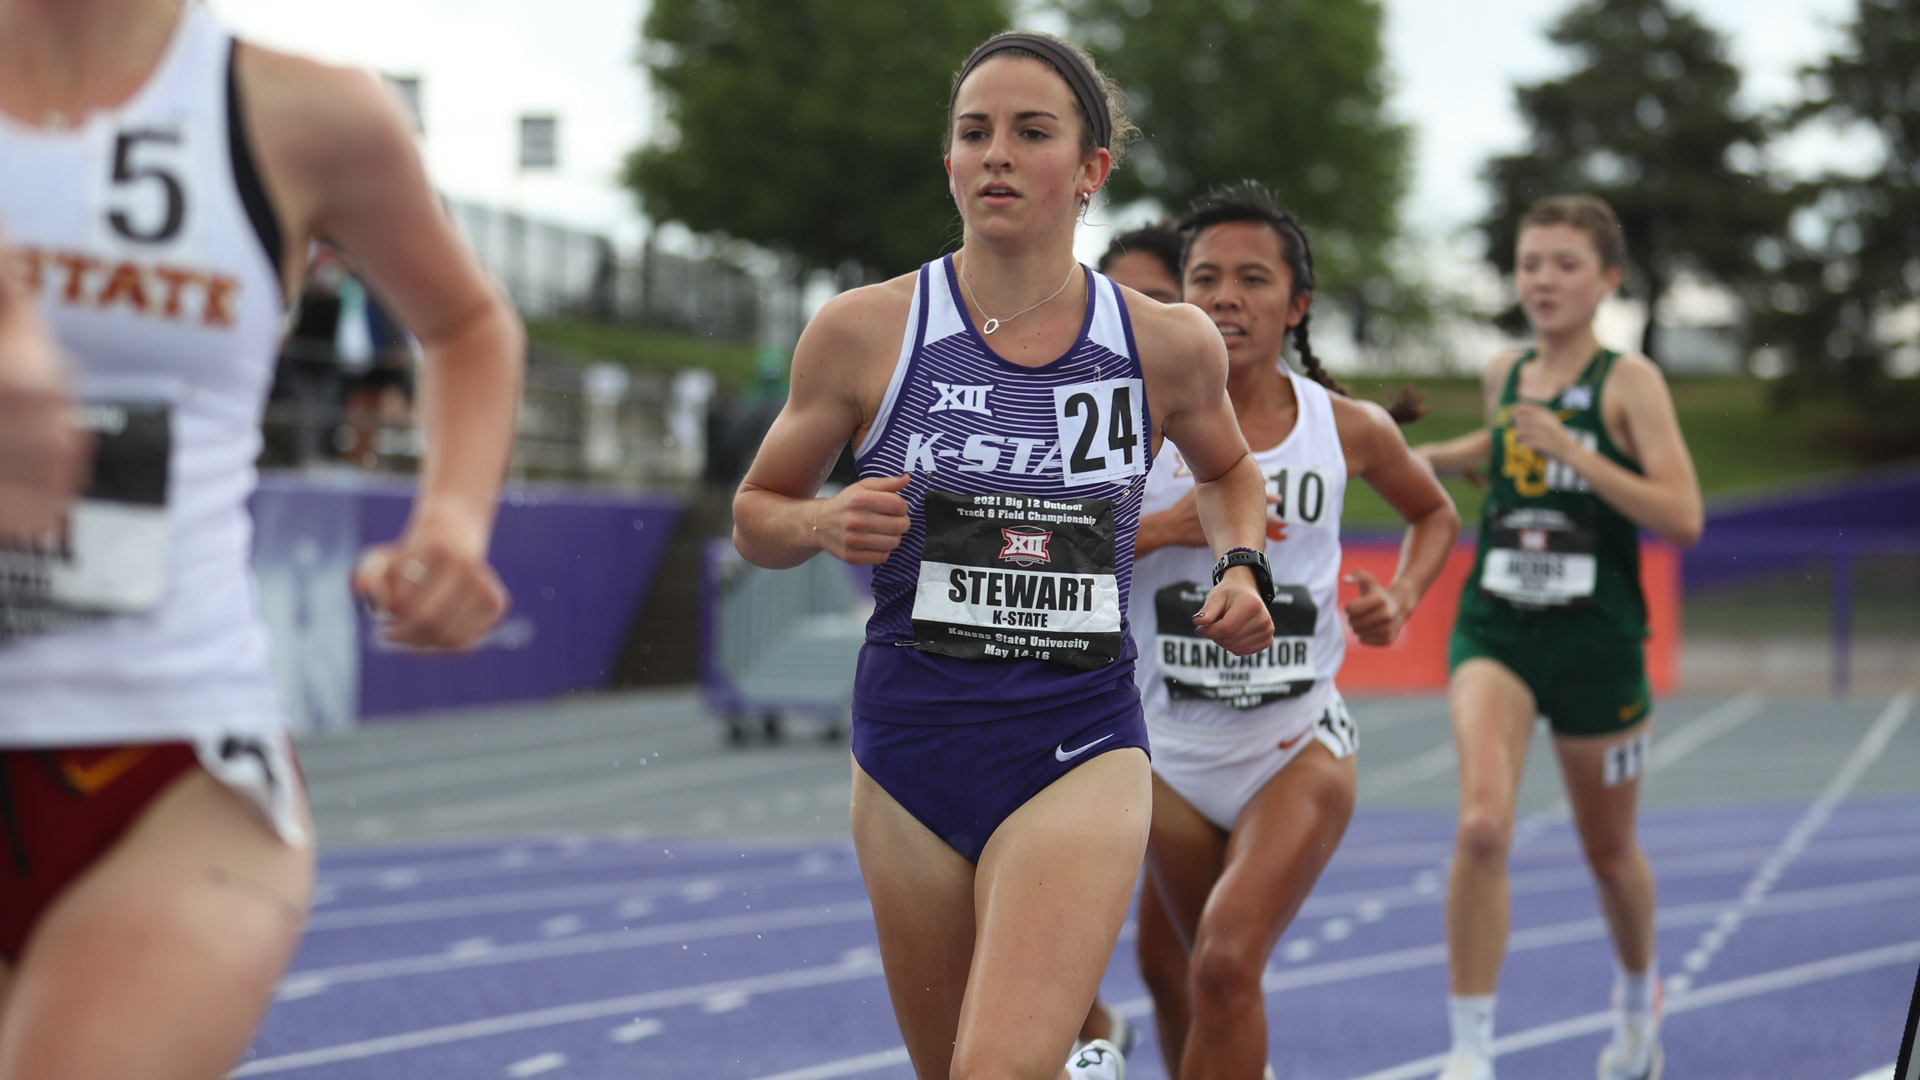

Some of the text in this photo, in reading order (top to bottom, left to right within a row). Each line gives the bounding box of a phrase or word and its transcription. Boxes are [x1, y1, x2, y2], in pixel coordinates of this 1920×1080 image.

[106, 126, 187, 244] 5
[1064, 386, 1137, 475] 24
[973, 496, 1083, 511] 2021 Big 12 Outdoor
[1269, 468, 1324, 523] 10
[957, 508, 1097, 527] Track & Field Championship
[948, 568, 1095, 612] STEWART
[992, 610, 1049, 628] K-STATE
[948, 627, 1089, 650] Kansas State University
[984, 643, 1009, 658] May
